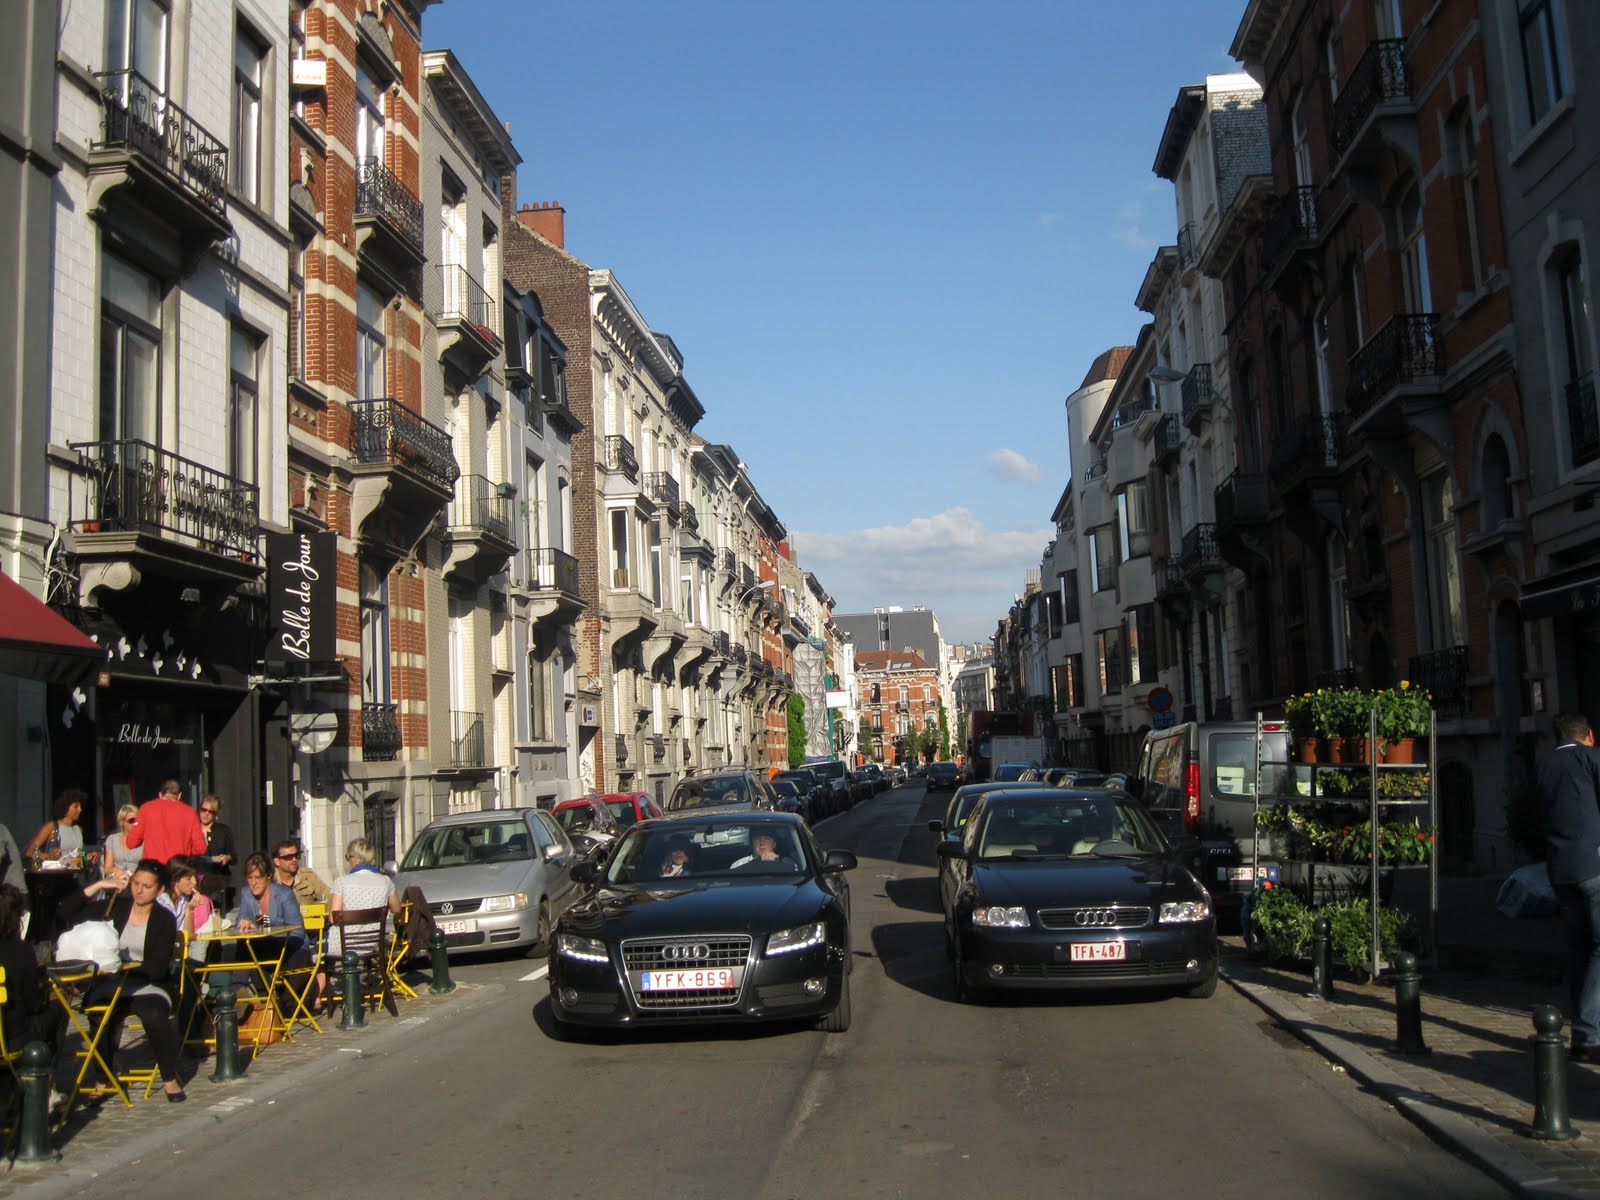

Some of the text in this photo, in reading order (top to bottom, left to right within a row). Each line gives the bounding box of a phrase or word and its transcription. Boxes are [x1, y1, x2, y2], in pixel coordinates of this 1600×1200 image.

[281, 533, 320, 660] Belle de Jour
[118, 723, 171, 749] Belle de Jour
[1073, 945, 1122, 959] TFA-487
[654, 971, 728, 988] YFK-869
